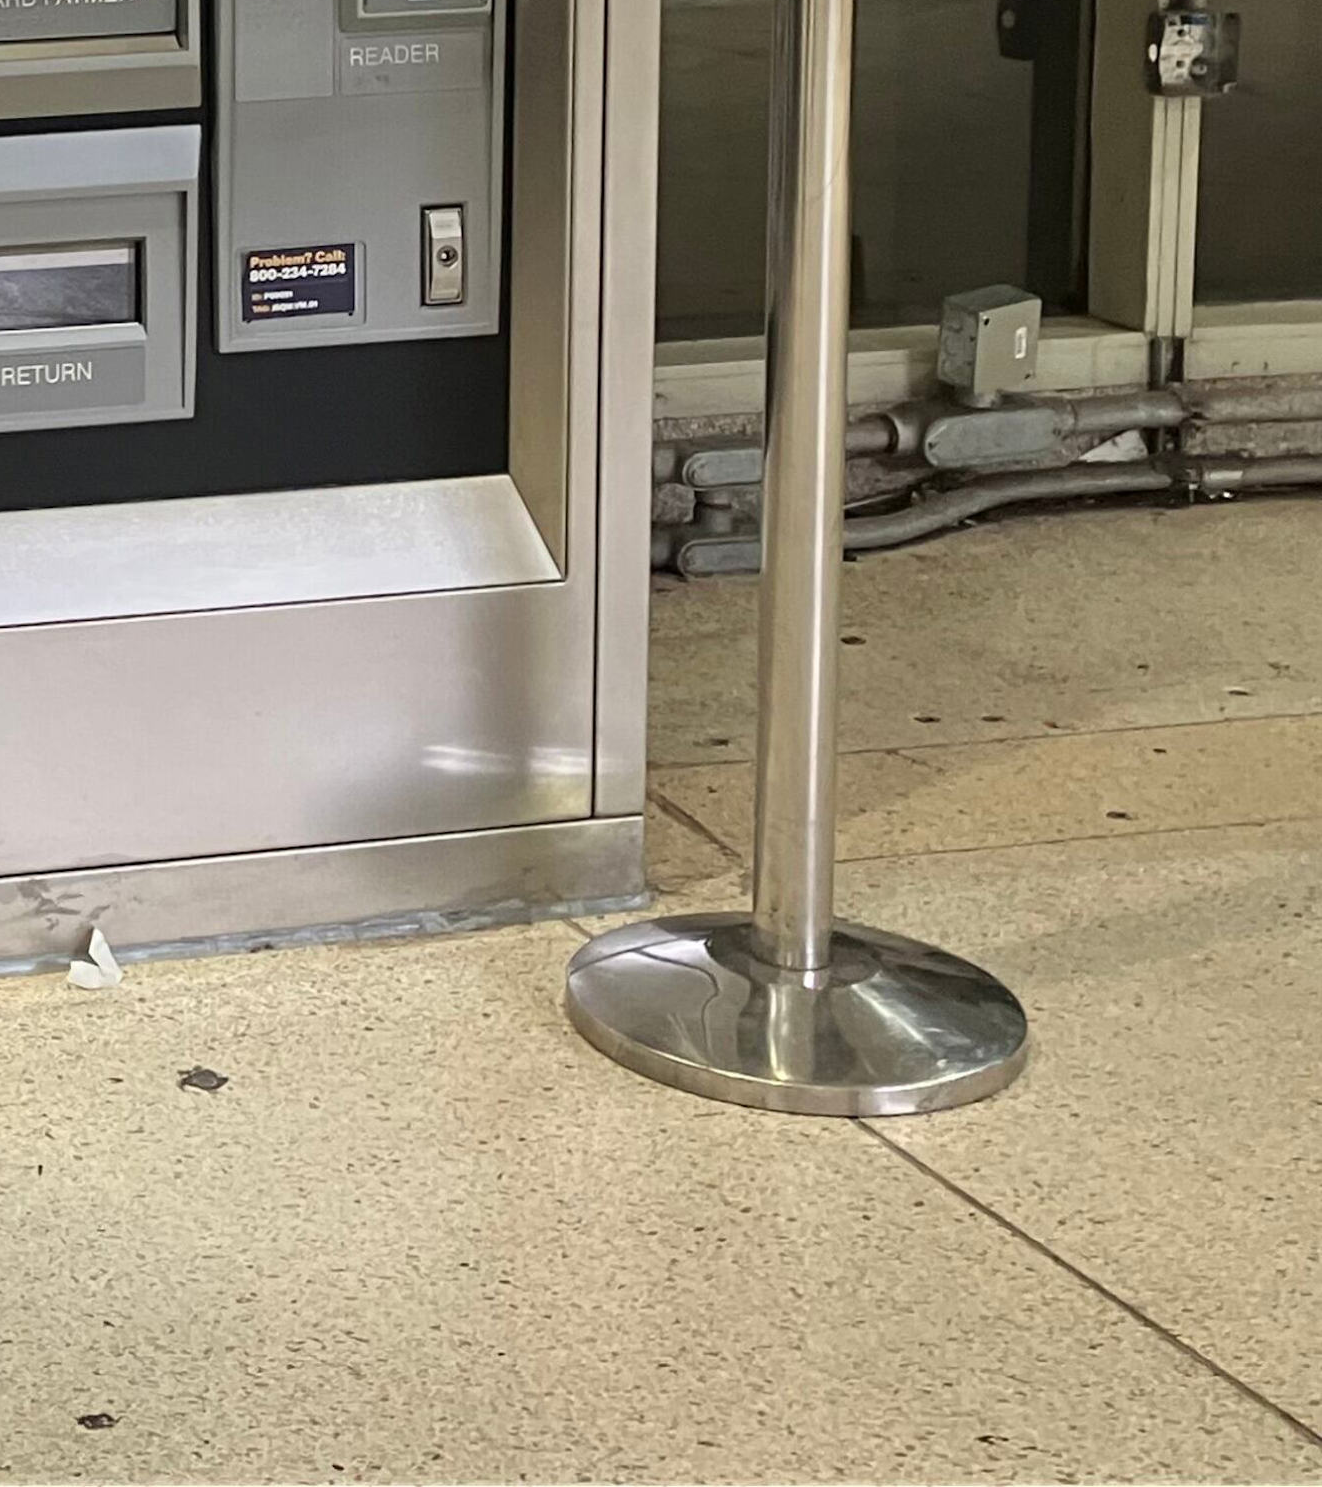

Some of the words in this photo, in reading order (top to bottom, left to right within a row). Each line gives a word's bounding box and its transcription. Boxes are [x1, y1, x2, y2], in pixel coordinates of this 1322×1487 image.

[350, 44, 438, 66] READER
[250, 252, 312, 268] Problem?
[250, 263, 346, 282] 800-234-7284
[2, 362, 91, 385] RETURN
